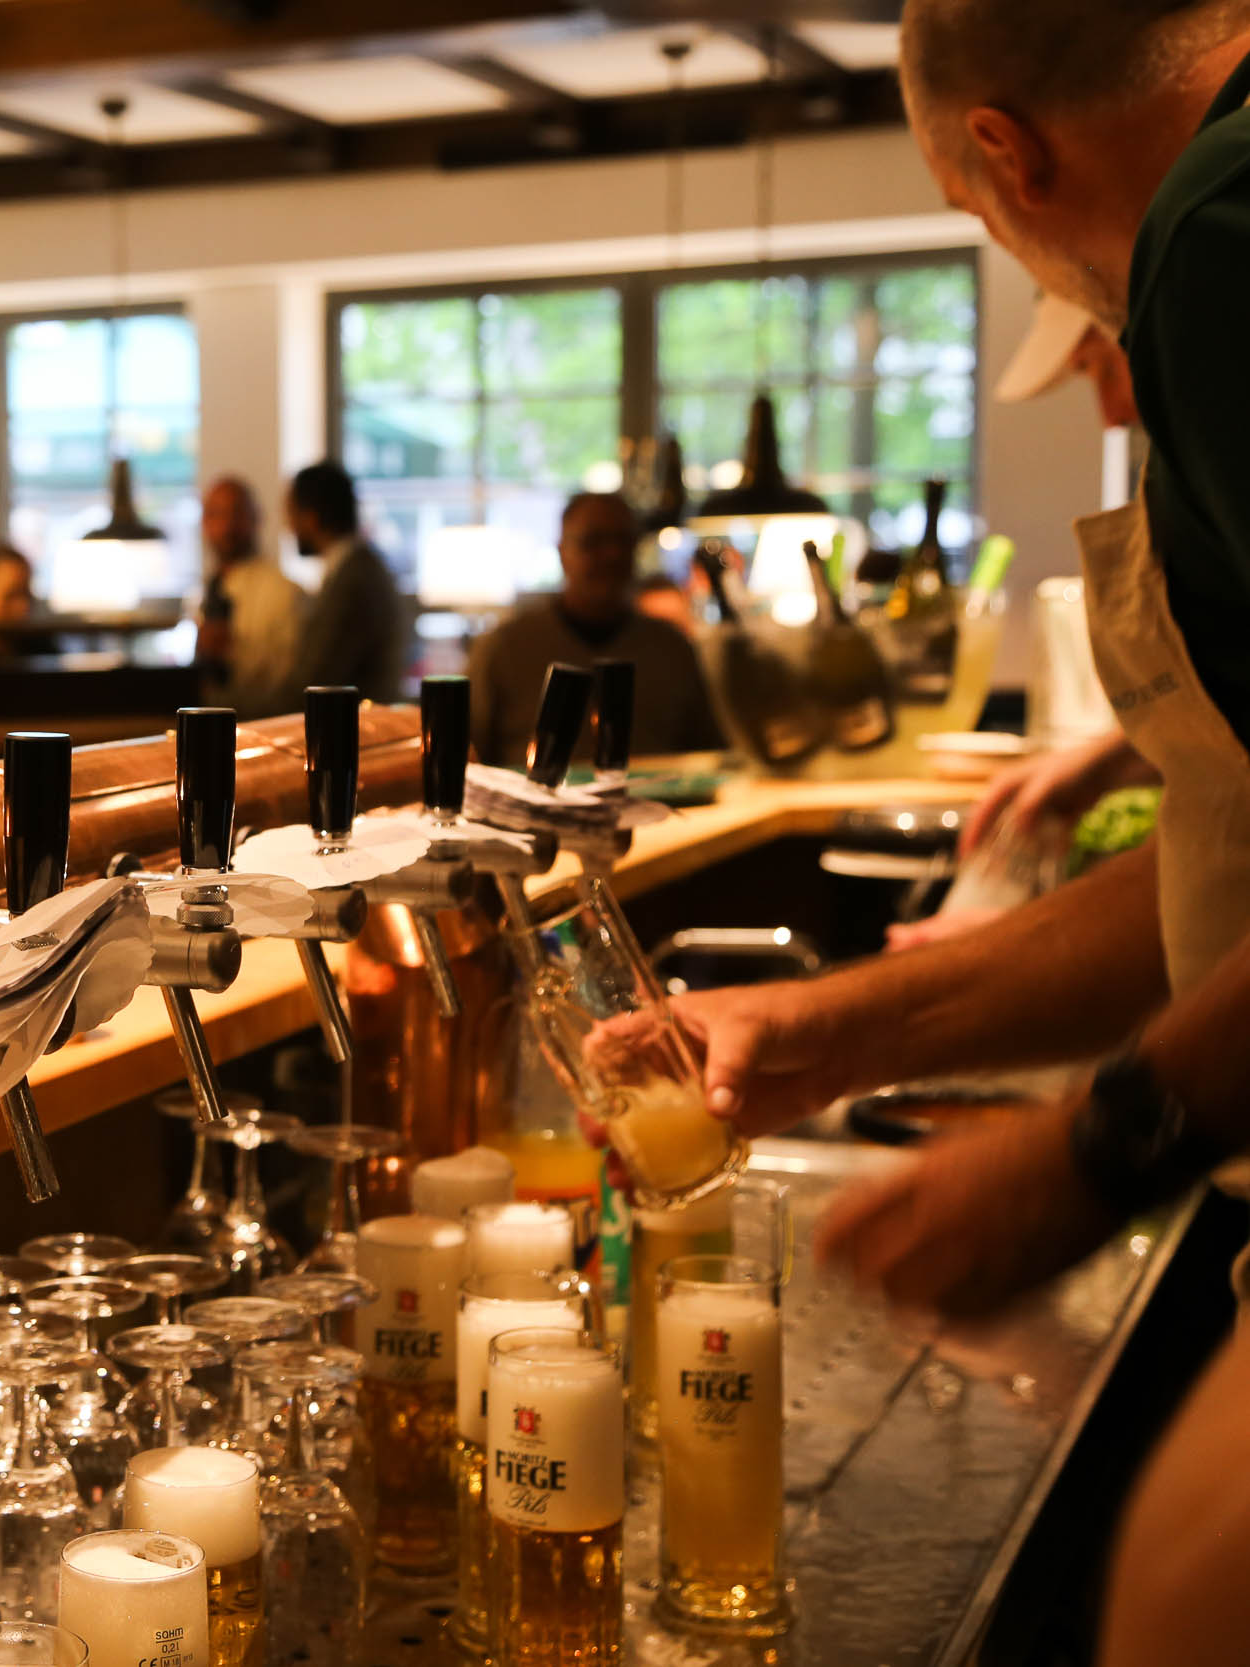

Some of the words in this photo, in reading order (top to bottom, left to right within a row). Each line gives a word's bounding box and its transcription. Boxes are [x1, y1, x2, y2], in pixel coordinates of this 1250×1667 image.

[375, 1330, 442, 1358] FIEGE
[680, 1370, 753, 1402] FIEGE
[496, 1449, 567, 1491] FIEGE
[506, 1486, 551, 1514] Pils
